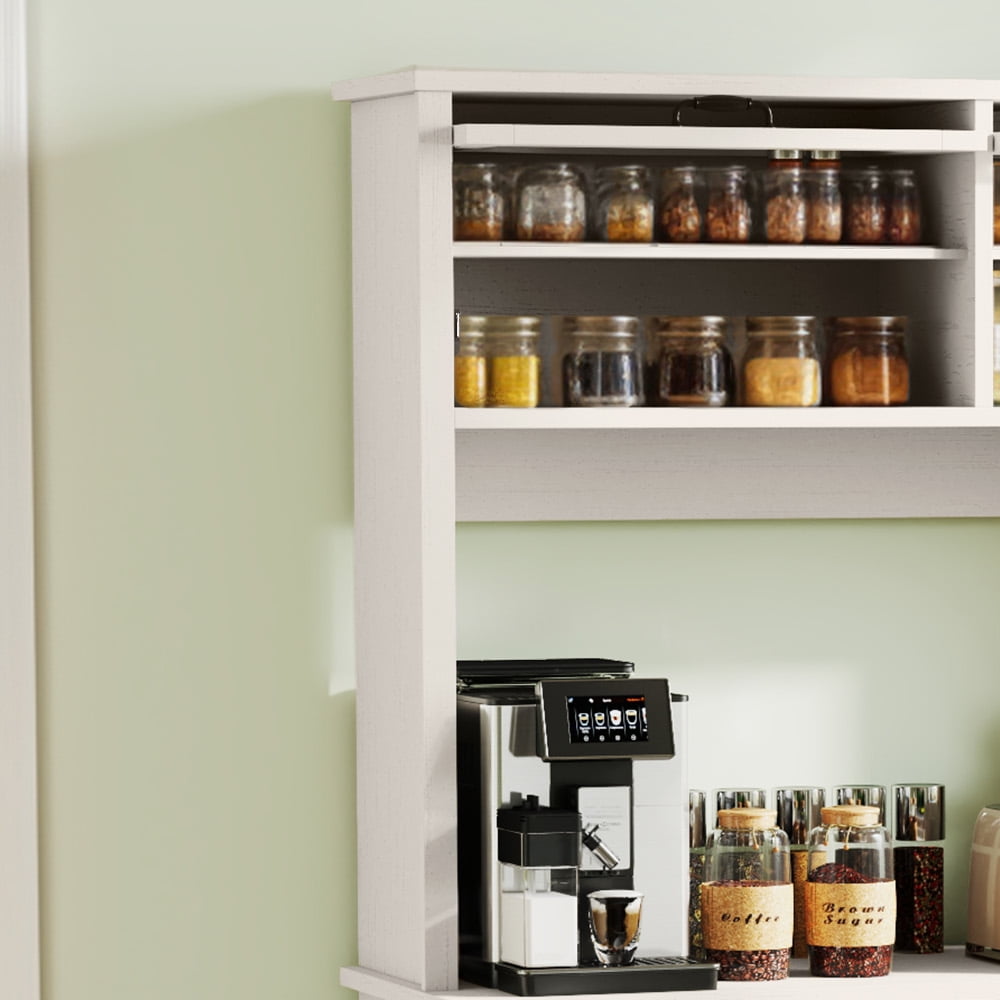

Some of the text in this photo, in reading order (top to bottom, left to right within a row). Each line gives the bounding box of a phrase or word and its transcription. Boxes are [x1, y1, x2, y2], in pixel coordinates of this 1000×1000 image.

[822, 903, 886, 913] Brown
[721, 912, 780, 924] Coffee
[823, 914, 884, 926] Sugar
